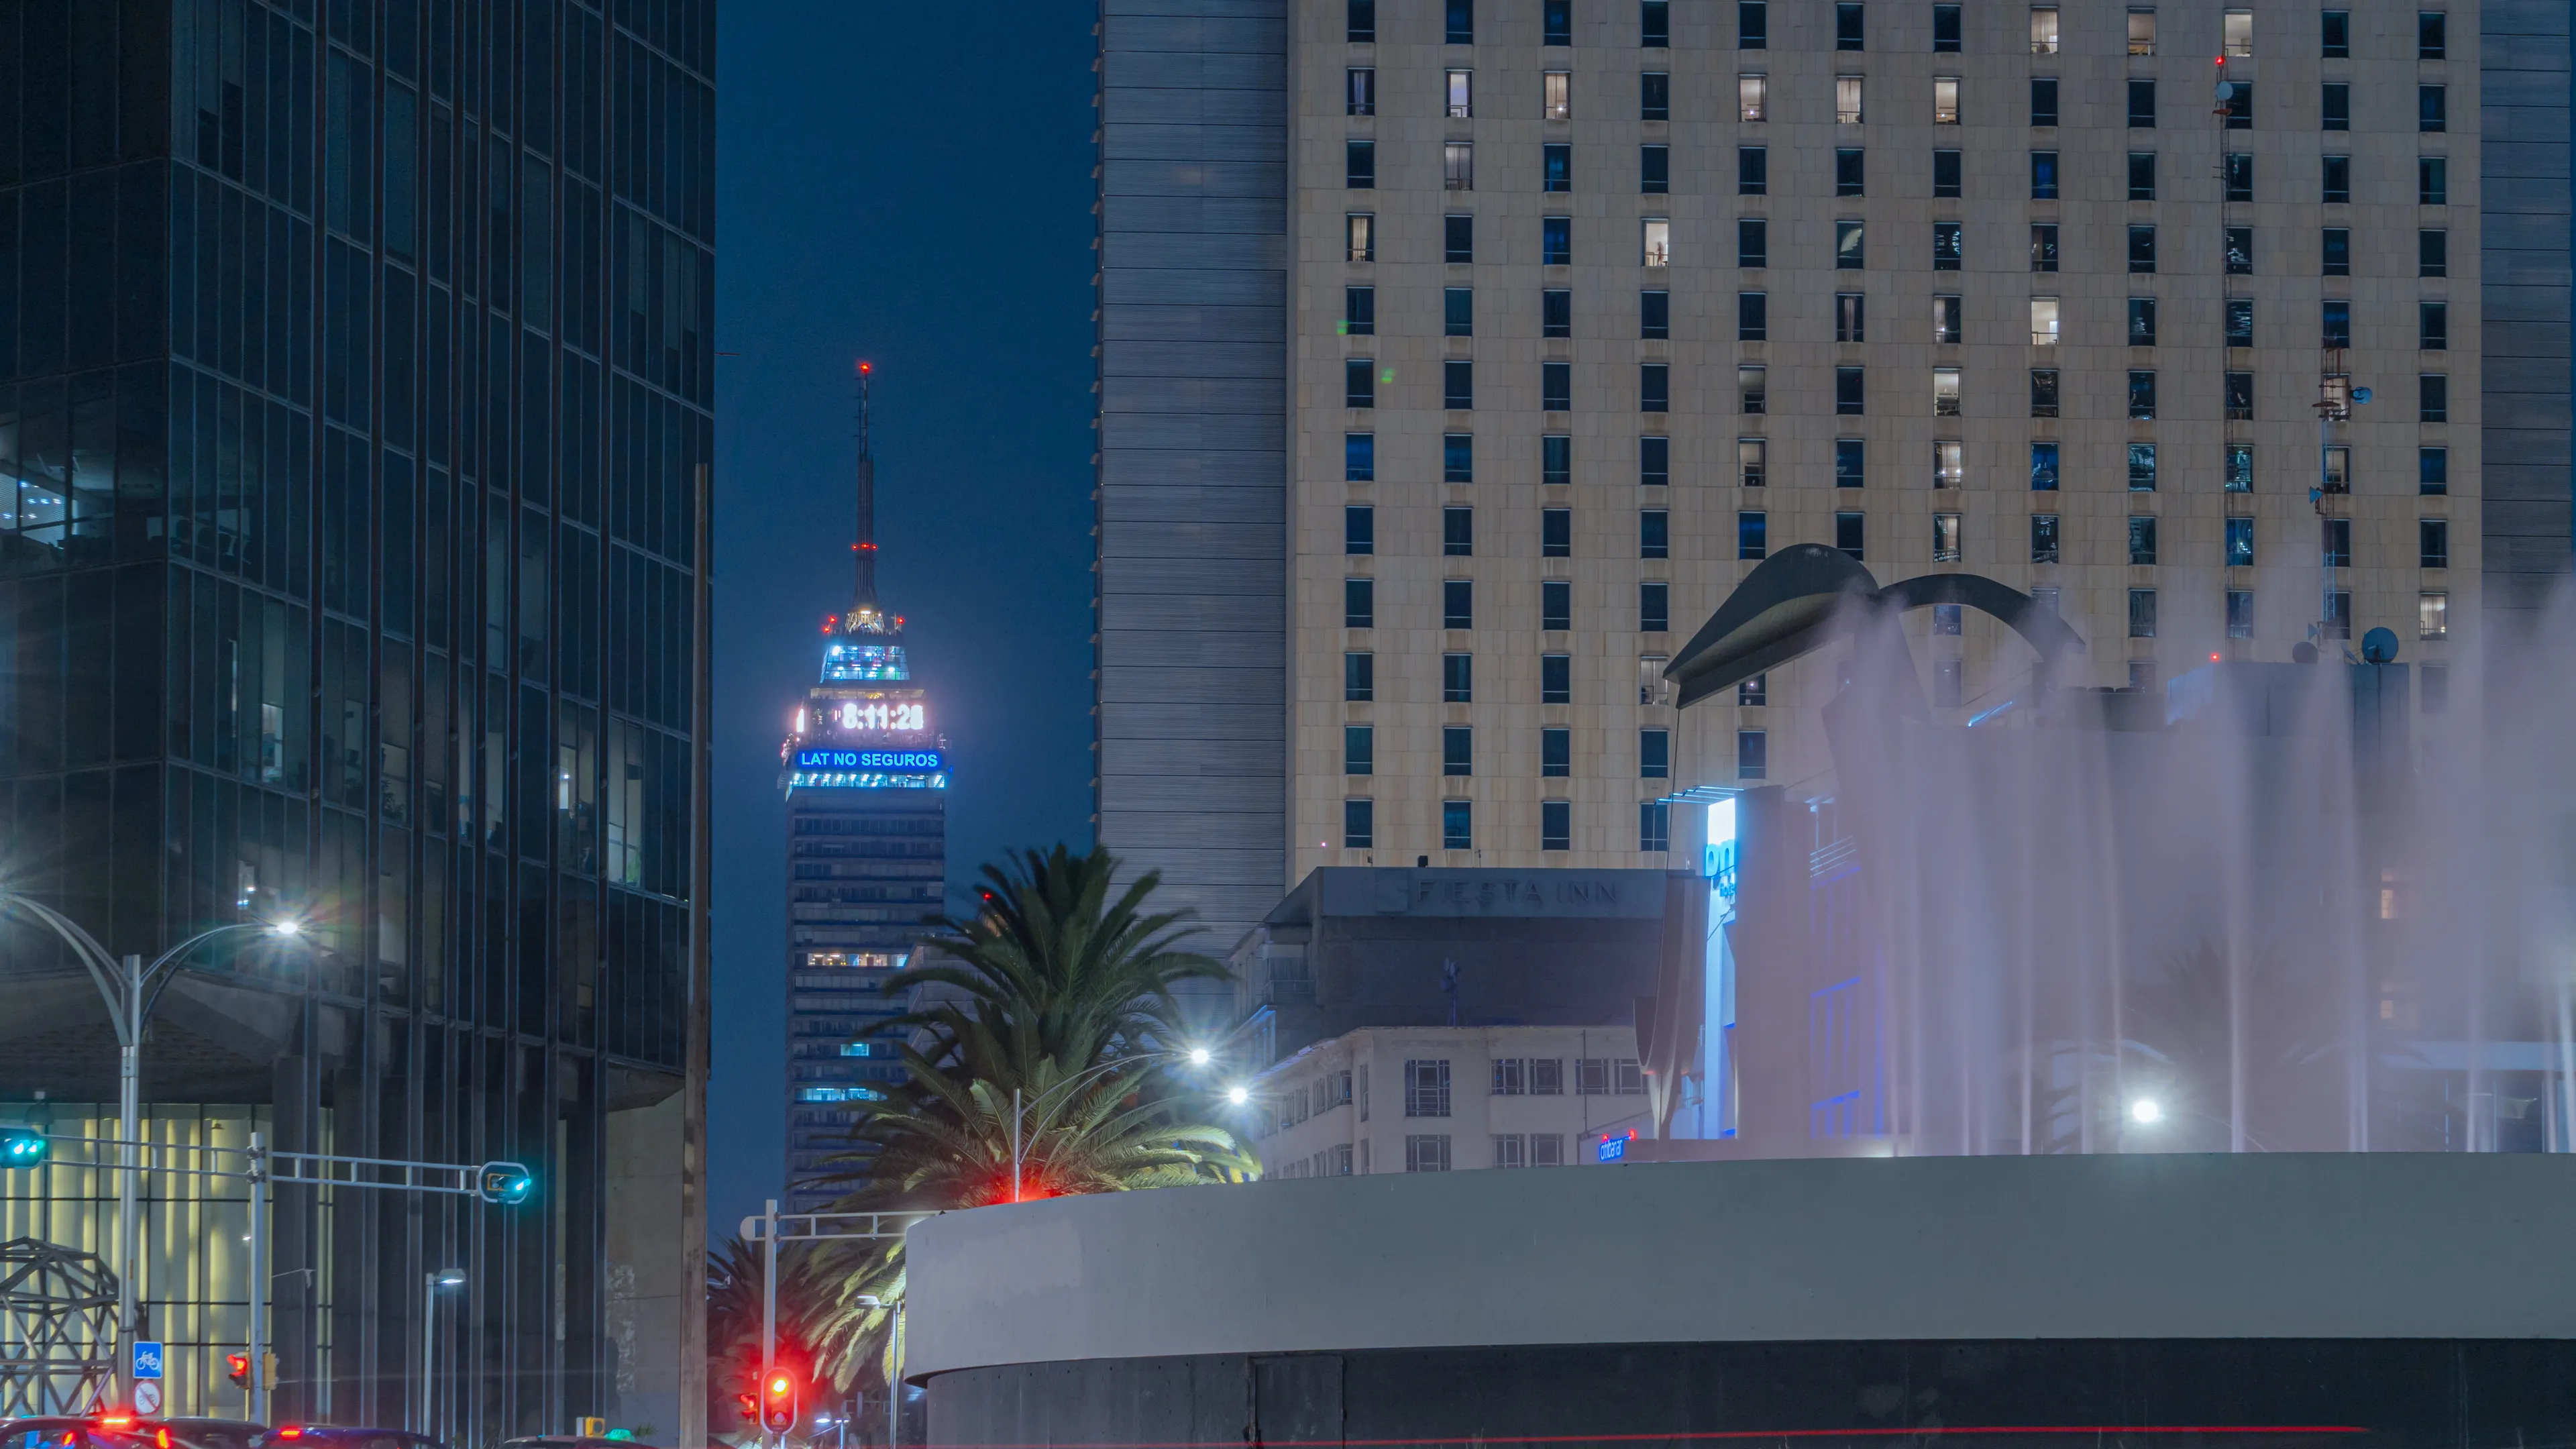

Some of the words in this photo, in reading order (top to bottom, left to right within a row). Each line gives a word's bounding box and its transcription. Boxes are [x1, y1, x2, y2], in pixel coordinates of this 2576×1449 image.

[843, 702, 924, 730] 8:11:2
[802, 753, 829, 765] LAT
[834, 753, 857, 766] NO
[861, 753, 938, 767] SEGUROS
[1417, 879, 1542, 904] FIESTA
[1556, 879, 1620, 904] INN
